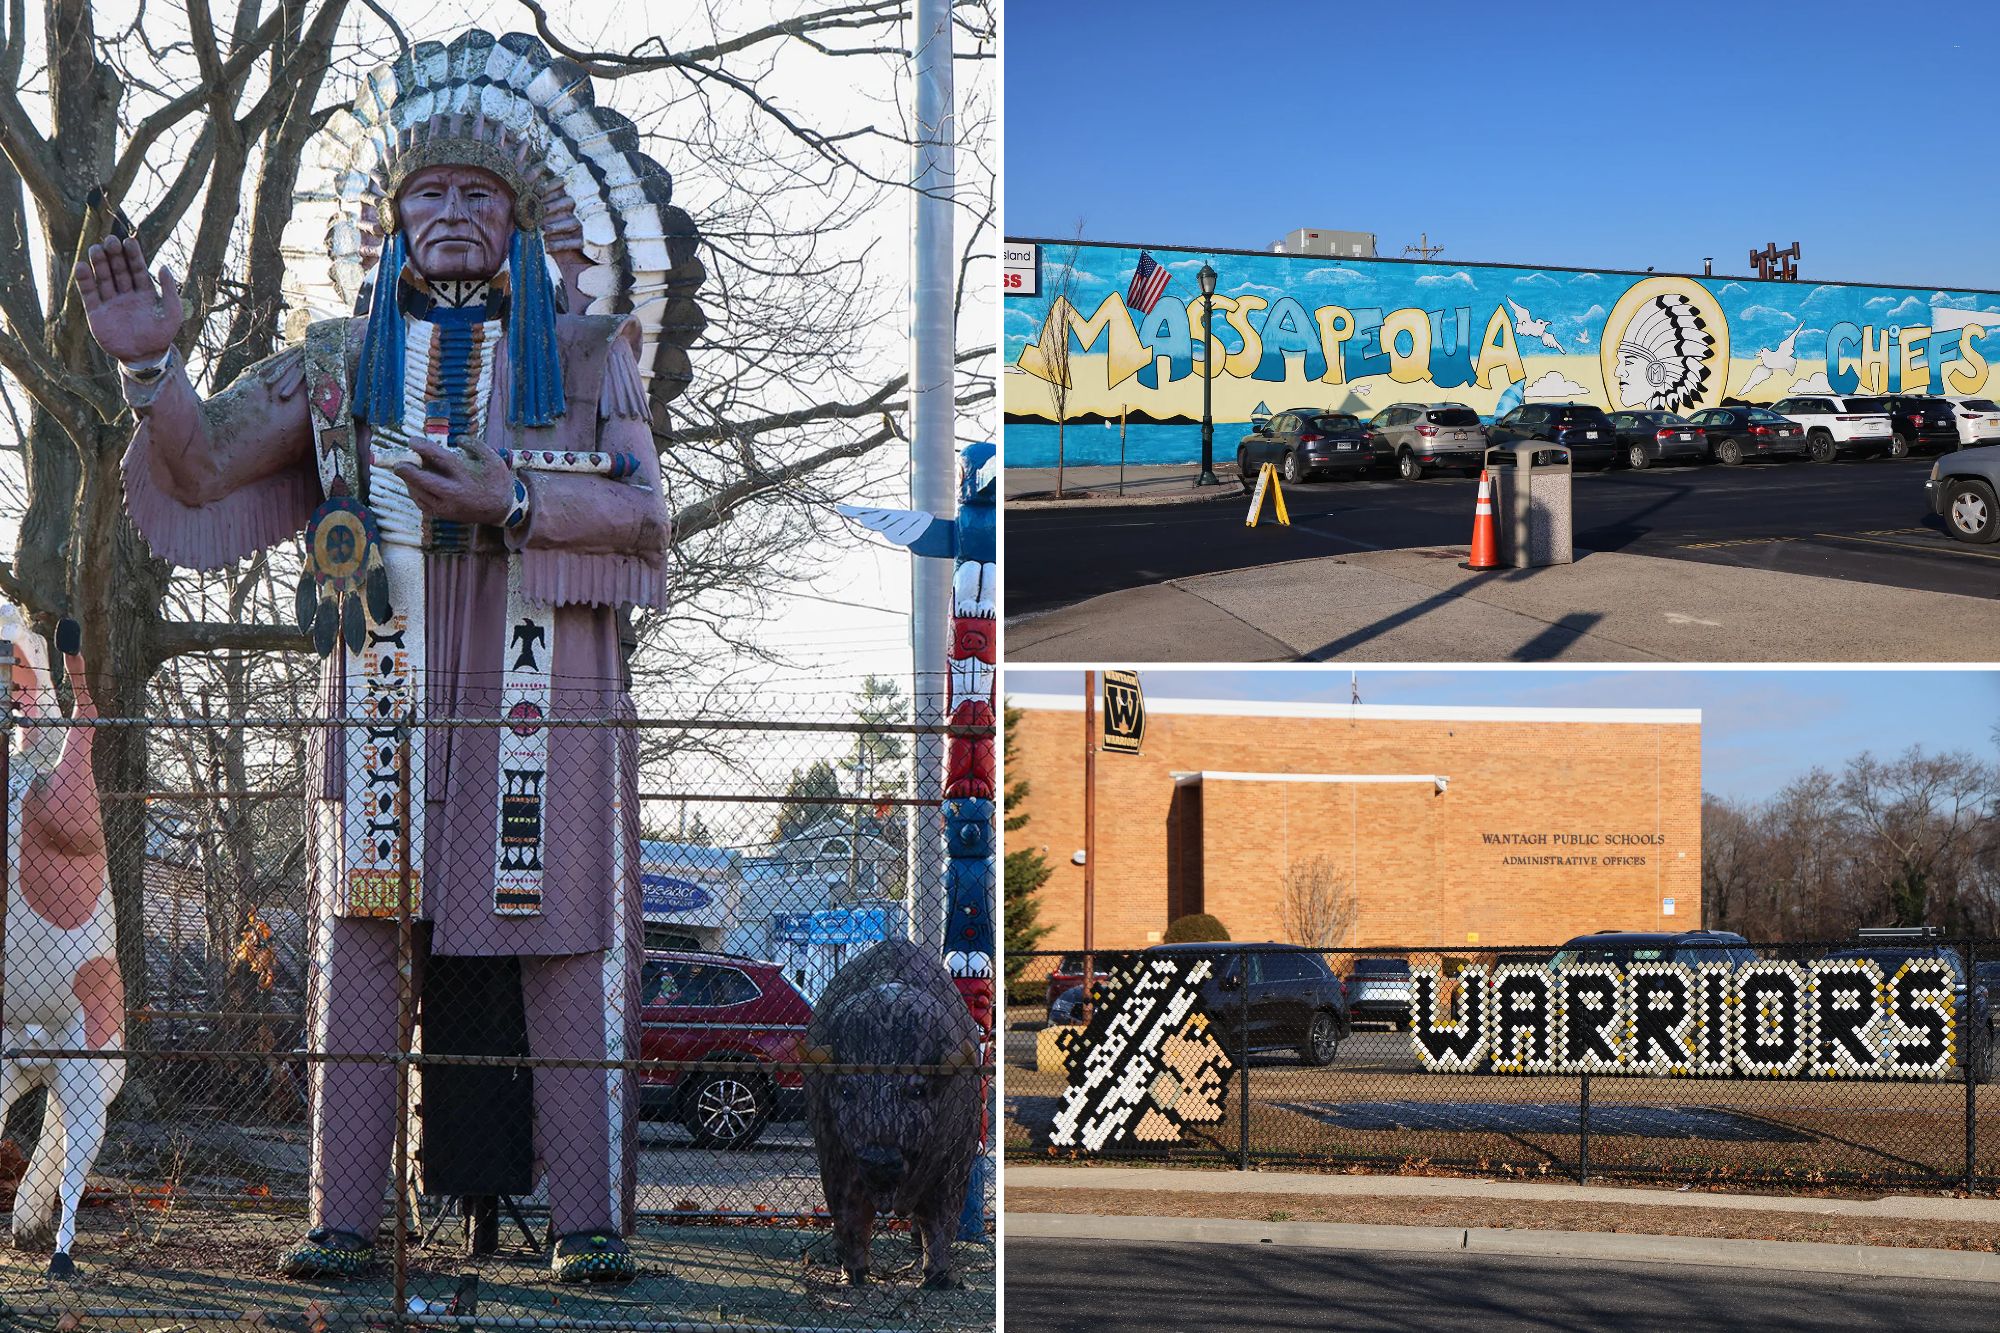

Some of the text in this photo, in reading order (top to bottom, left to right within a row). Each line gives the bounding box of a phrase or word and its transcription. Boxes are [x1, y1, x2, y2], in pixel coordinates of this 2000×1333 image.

[1017, 290, 1526, 390] MASSAPEQUA
[1105, 683, 1140, 733] W
[1105, 734, 1139, 747] WARRIORS
[1482, 833, 1665, 845] WANTAGH PUBLIC SCHOOLS
[1502, 856, 1646, 865] ADMINISTRATIVE OFFICES
[1408, 958, 1957, 1078] WARRIORS
